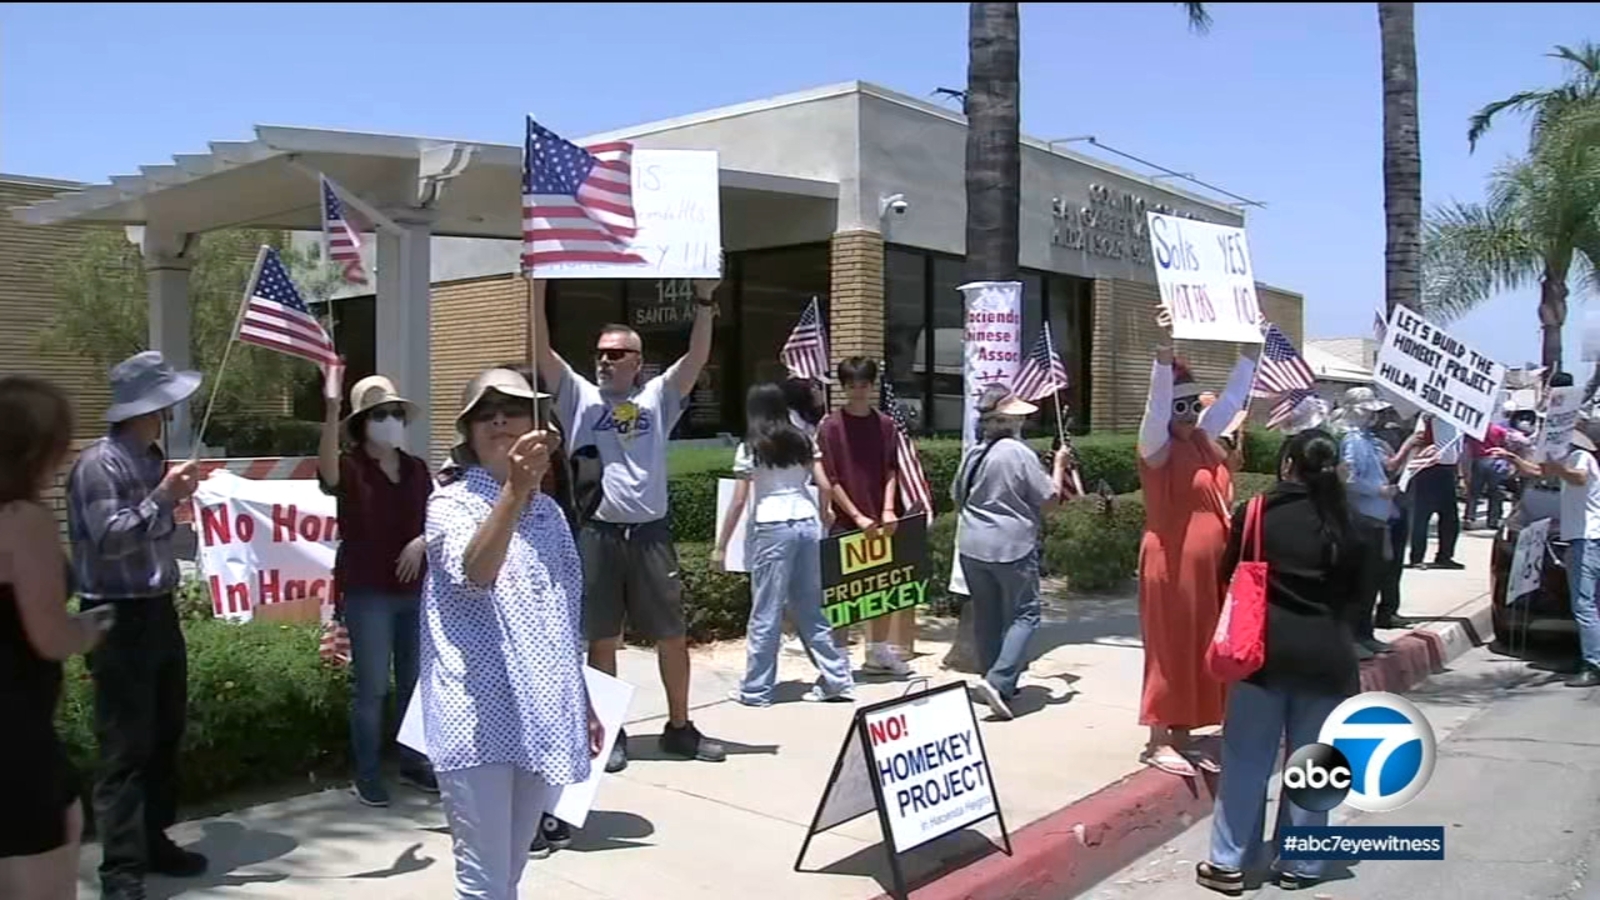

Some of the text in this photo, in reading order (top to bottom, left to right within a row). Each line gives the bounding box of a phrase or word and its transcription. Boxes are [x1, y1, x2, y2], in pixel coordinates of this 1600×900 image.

[1151, 215, 1199, 272] Solis
[1216, 232, 1247, 276] YES
[635, 306, 678, 325] SANTA
[1431, 330, 1466, 359] BUILD
[1469, 350, 1495, 376] THE
[1379, 362, 1485, 430] HILDA SOLIS CITY
[1428, 370, 1449, 390] IN
[1444, 359, 1497, 395] PROJECT
[201, 501, 255, 547] No
[844, 534, 887, 569] NO
[209, 574, 251, 615] In
[821, 578, 930, 628] OMEKEY
[823, 565, 915, 605] PROJECT
[869, 713, 909, 747] NO!
[878, 729, 973, 787] HOMEKEY
[897, 760, 985, 818] PROJECT
